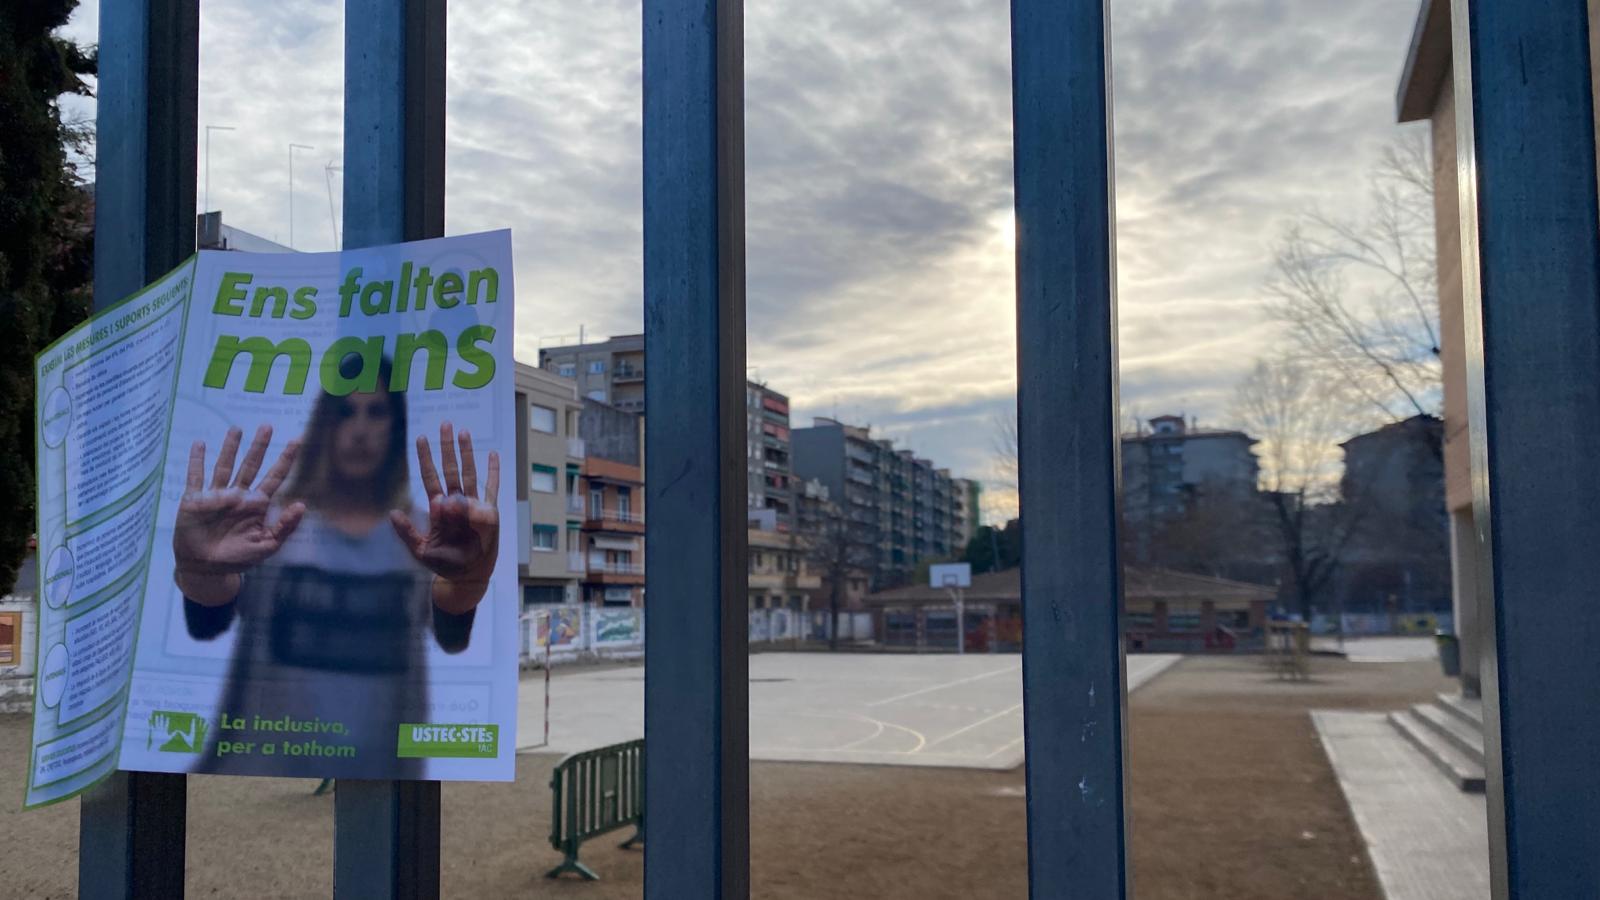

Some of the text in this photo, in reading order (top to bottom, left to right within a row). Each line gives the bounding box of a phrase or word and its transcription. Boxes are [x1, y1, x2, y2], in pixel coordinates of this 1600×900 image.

[211, 261, 499, 320] Ens falten
[63, 344, 75, 363] LES
[75, 324, 109, 355] MESURES
[115, 306, 151, 332] SUPORTS
[202, 324, 497, 397] mans
[217, 740, 356, 757] per a tothom
[220, 713, 350, 736] La inclusiva,
